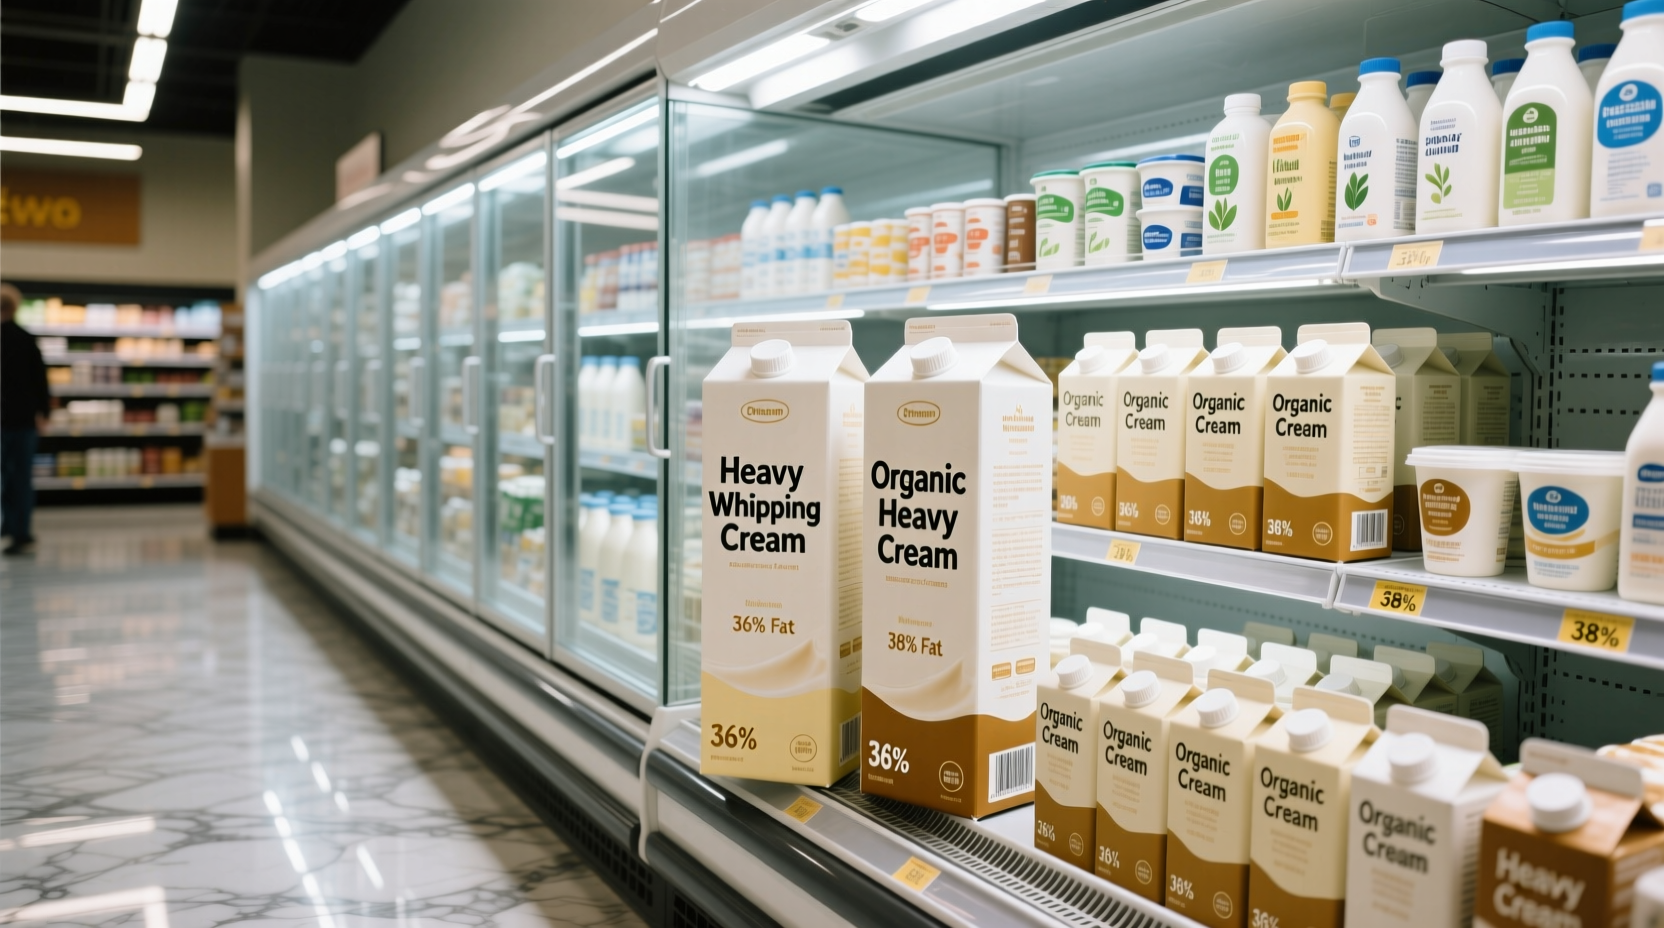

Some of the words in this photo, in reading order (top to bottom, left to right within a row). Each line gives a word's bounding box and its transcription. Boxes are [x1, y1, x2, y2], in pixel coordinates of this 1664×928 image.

[1063, 390, 1104, 410] Organic
[1123, 391, 1169, 411] Organic
[1192, 392, 1245, 415] Organic
[1272, 393, 1332, 417] Organic
[1065, 411, 1101, 428] Cream
[1125, 413, 1166, 431] Cream
[1195, 415, 1241, 435] Cream
[1275, 417, 1328, 438] Cream
[720, 456, 804, 492] Heavy
[871, 460, 967, 499] Organic
[708, 491, 821, 527] Whipping
[878, 498, 959, 539] Heavy
[720, 522, 806, 553] Cream
[877, 534, 958, 570] Cream
[1380, 590, 1416, 612] 38%
[732, 615, 766, 634] 36%
[771, 617, 796, 635] Fat
[1571, 620, 1620, 648] 38%
[888, 631, 917, 654] 38%
[921, 637, 943, 657] Fat
[1040, 702, 1083, 732] Organic
[710, 723, 757, 750] 36%
[1042, 726, 1079, 754] Cream
[1103, 720, 1152, 752] Organic
[868, 739, 910, 774] 36%
[1105, 745, 1148, 776] Cream
[1175, 742, 1231, 776] Organic
[1178, 769, 1227, 802] Cream
[1260, 767, 1325, 805] Organic
[1264, 796, 1319, 832] Cream
[1358, 800, 1437, 846] Organic
[1362, 832, 1429, 875] Cream
[1496, 848, 1585, 911] Heavy
[1493, 881, 1583, 928] Cream
